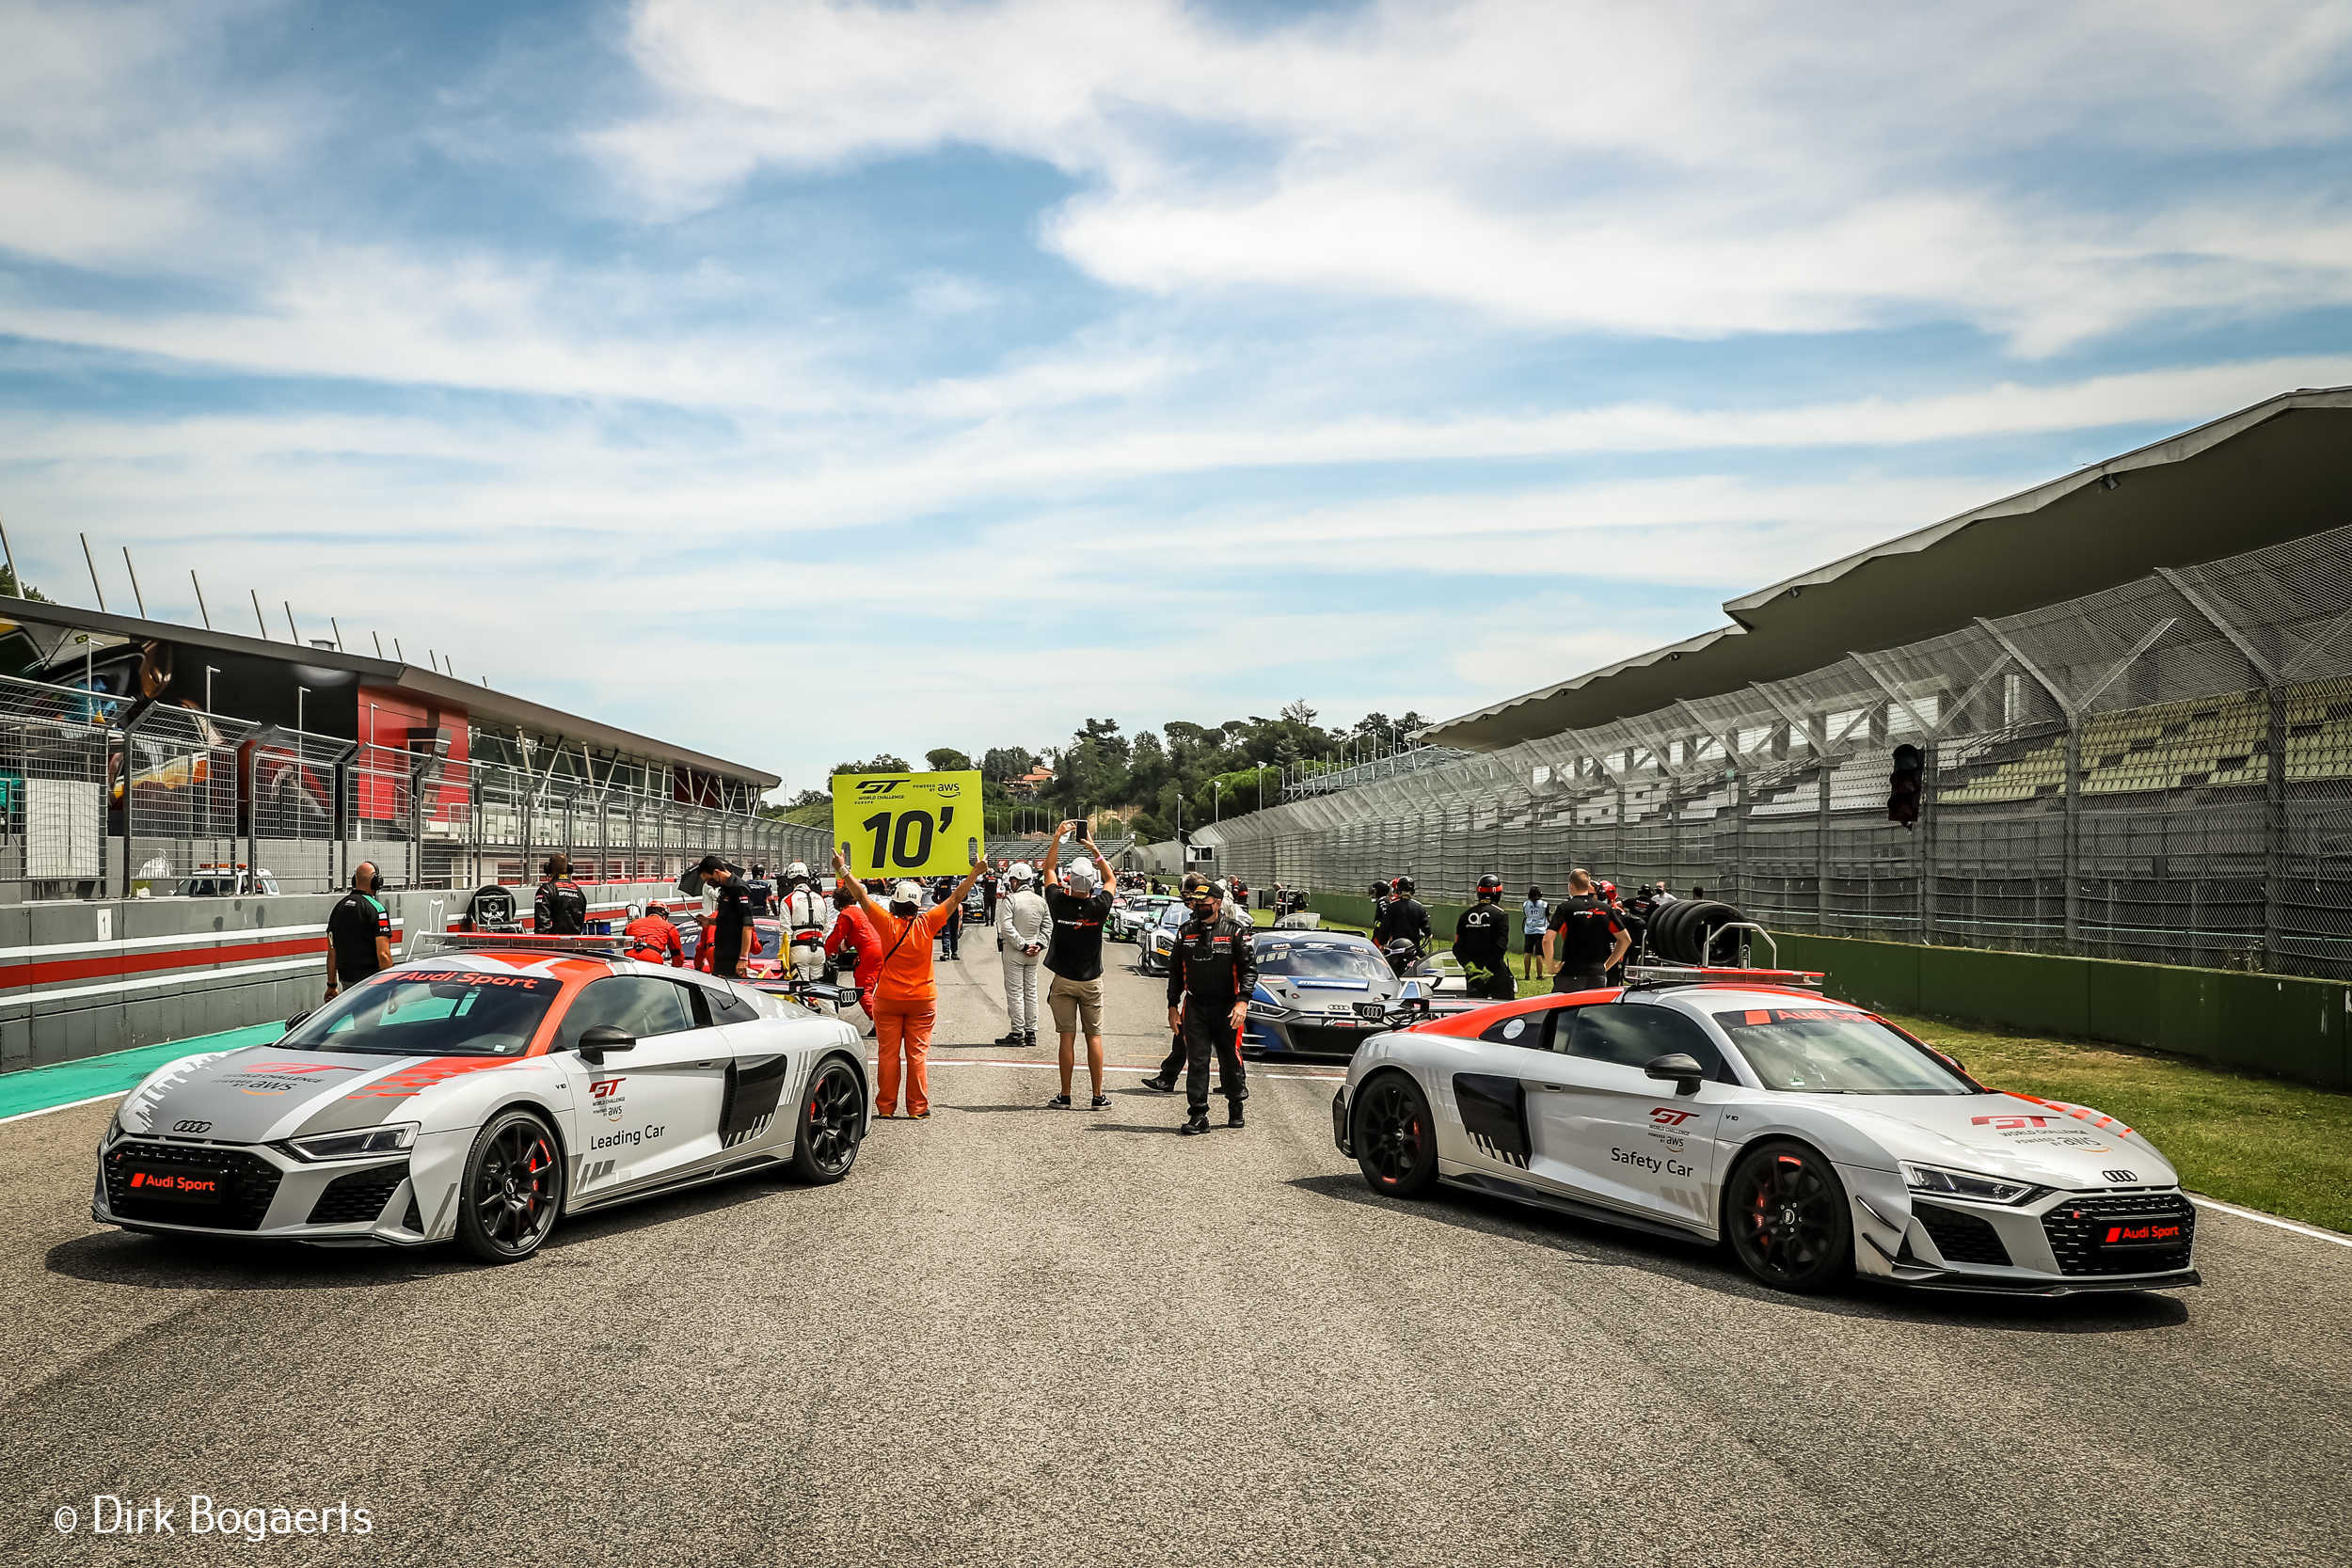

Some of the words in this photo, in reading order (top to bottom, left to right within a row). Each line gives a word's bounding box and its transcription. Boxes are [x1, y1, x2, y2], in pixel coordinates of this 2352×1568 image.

[855, 779, 912, 794] GT
[397, 971, 457, 982] Audi
[457, 972, 539, 989] Sport
[1776, 1010, 1831, 1021] Audi
[588, 1077, 627, 1099] GT
[608, 1106, 623, 1116] aws
[1649, 1107, 1701, 1126] GT
[590, 1130, 641, 1150] Leading
[644, 1125, 665, 1139] Car
[1666, 1136, 1684, 1147] aws
[1611, 1147, 1662, 1173] Safety
[1666, 1159, 1693, 1177] Car
[145, 1174, 174, 1188] Audi
[177, 1176, 215, 1192] Sport
[2122, 1227, 2150, 1239] Audi
[2152, 1226, 2180, 1239] Sport
